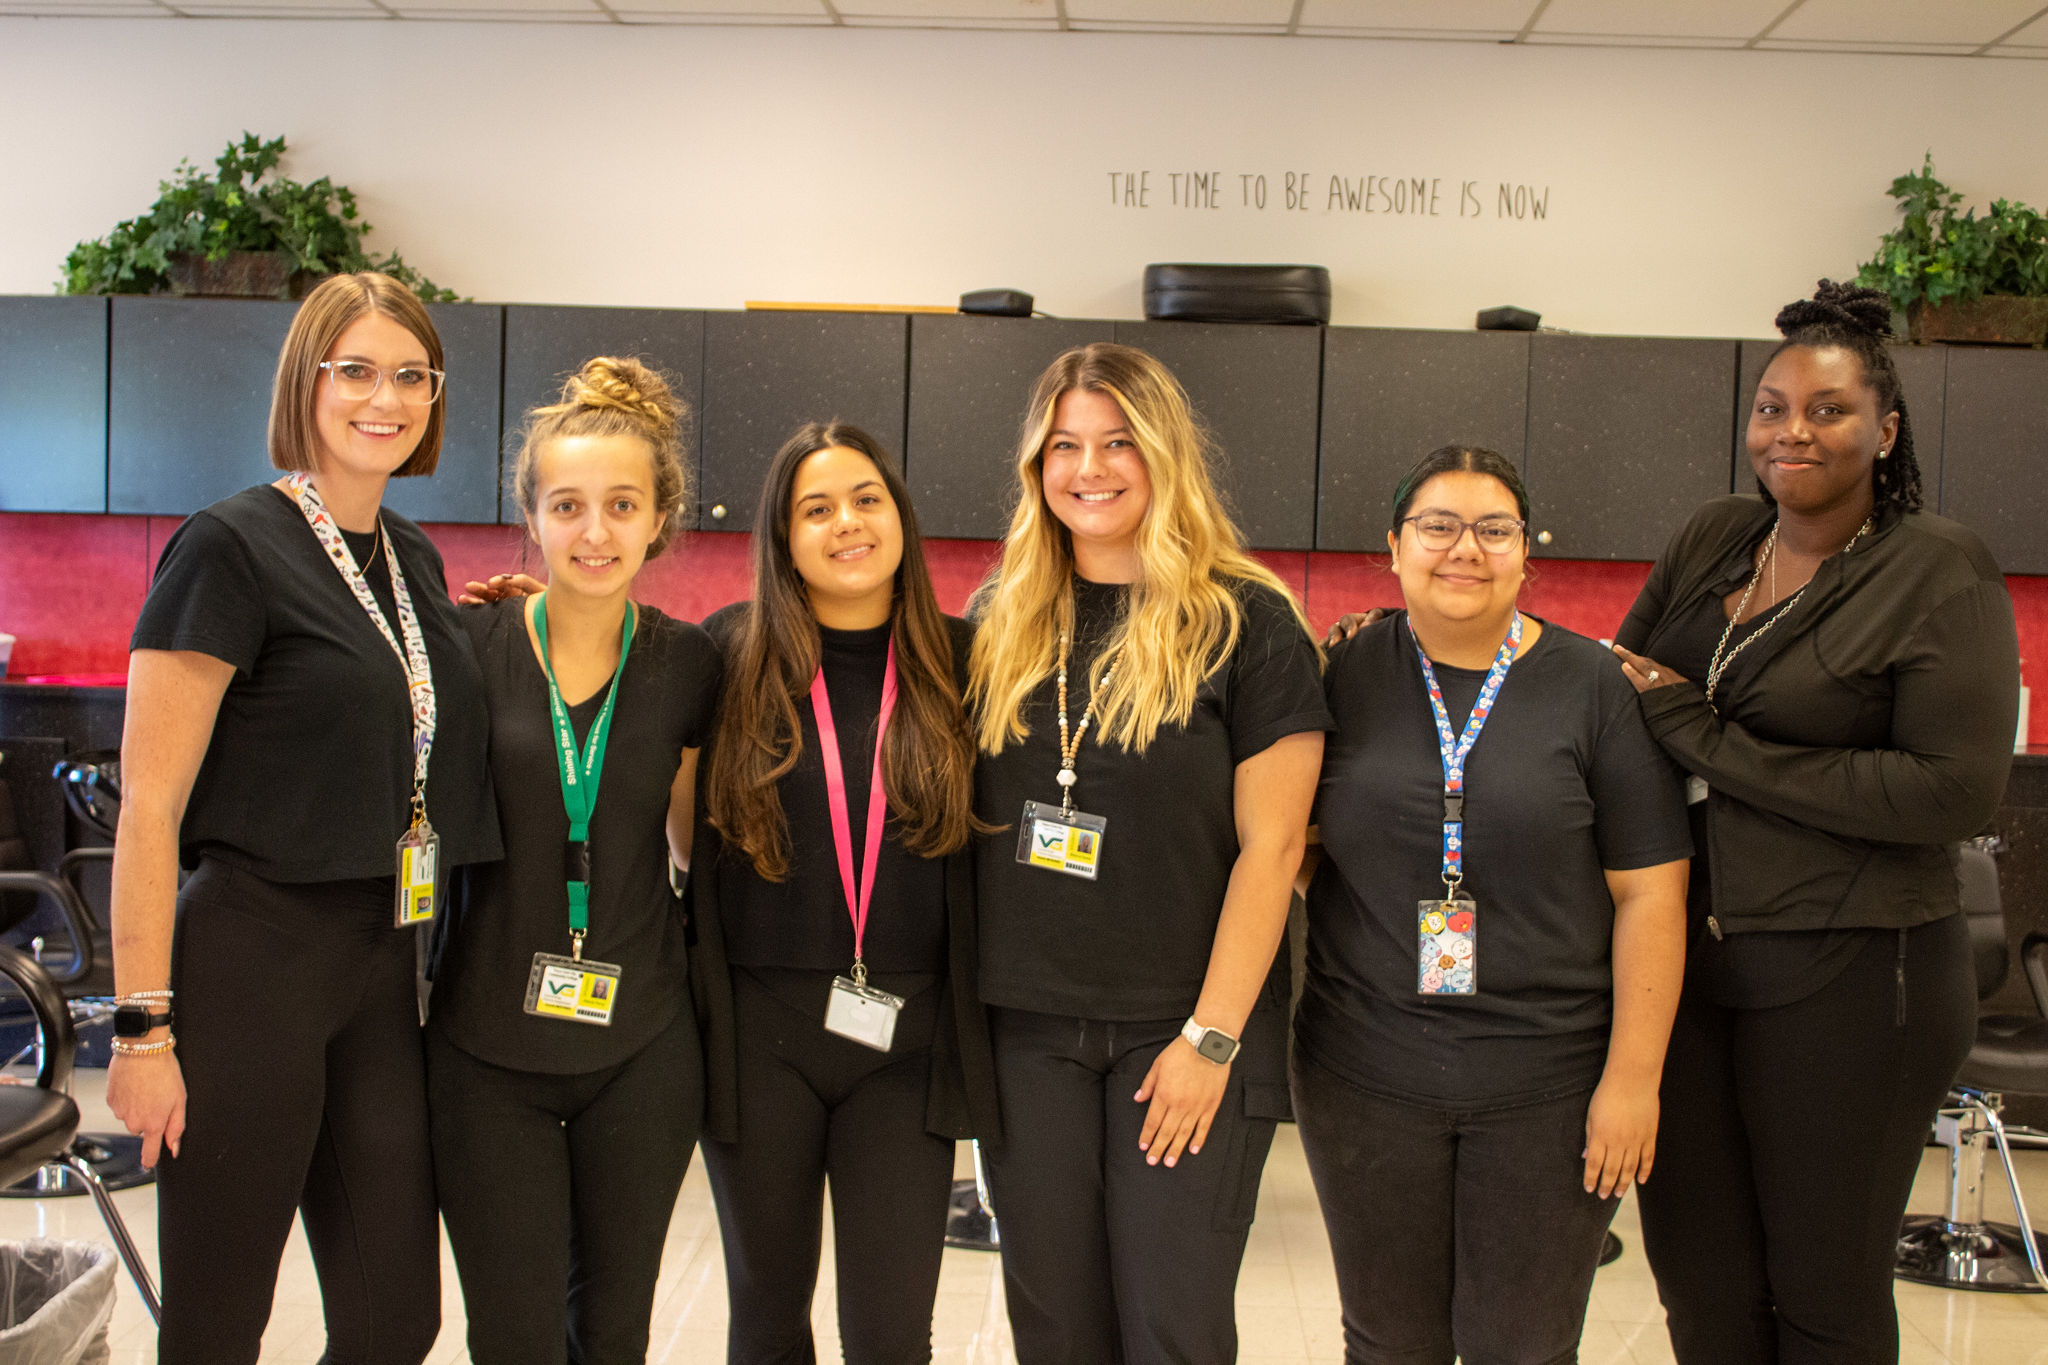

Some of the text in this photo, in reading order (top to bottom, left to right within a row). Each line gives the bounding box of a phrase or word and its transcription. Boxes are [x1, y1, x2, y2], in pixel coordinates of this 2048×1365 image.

[1107, 170, 1550, 221] THE TIME TO BE AWESOME IS NOW
[560, 728, 570, 749] Star
[565, 749, 577, 785] Shining
